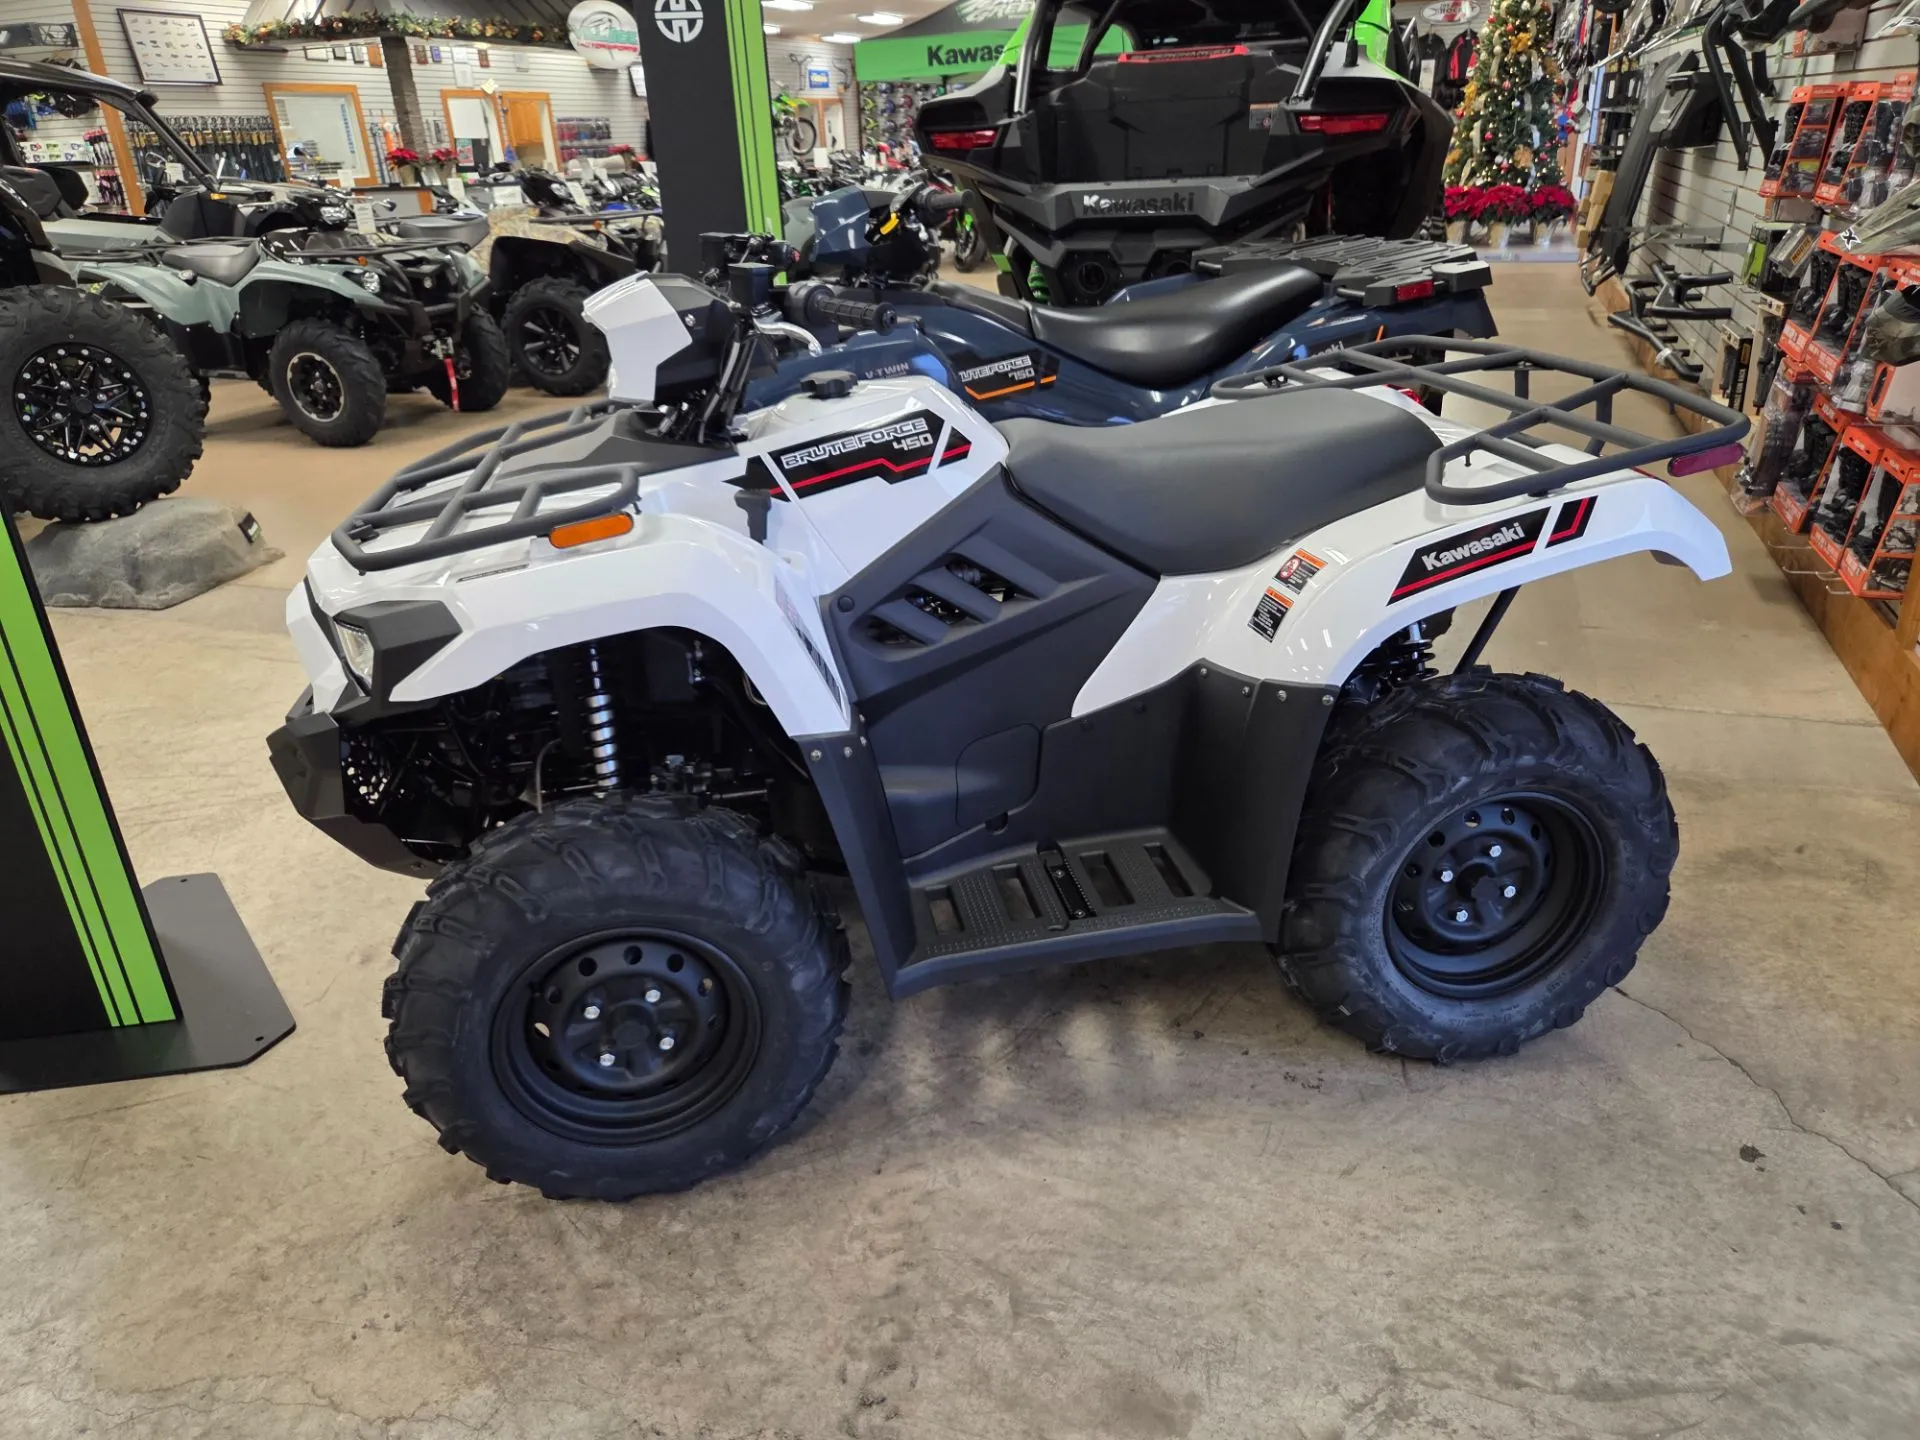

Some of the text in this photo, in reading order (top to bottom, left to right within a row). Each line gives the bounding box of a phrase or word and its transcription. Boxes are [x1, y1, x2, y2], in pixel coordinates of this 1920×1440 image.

[926, 43, 1005, 67] Kawas
[1083, 191, 1195, 216] Kawasaki
[1008, 367, 1035, 381] 750
[893, 433, 934, 451] 450
[1421, 522, 1526, 571] Kawasaki
